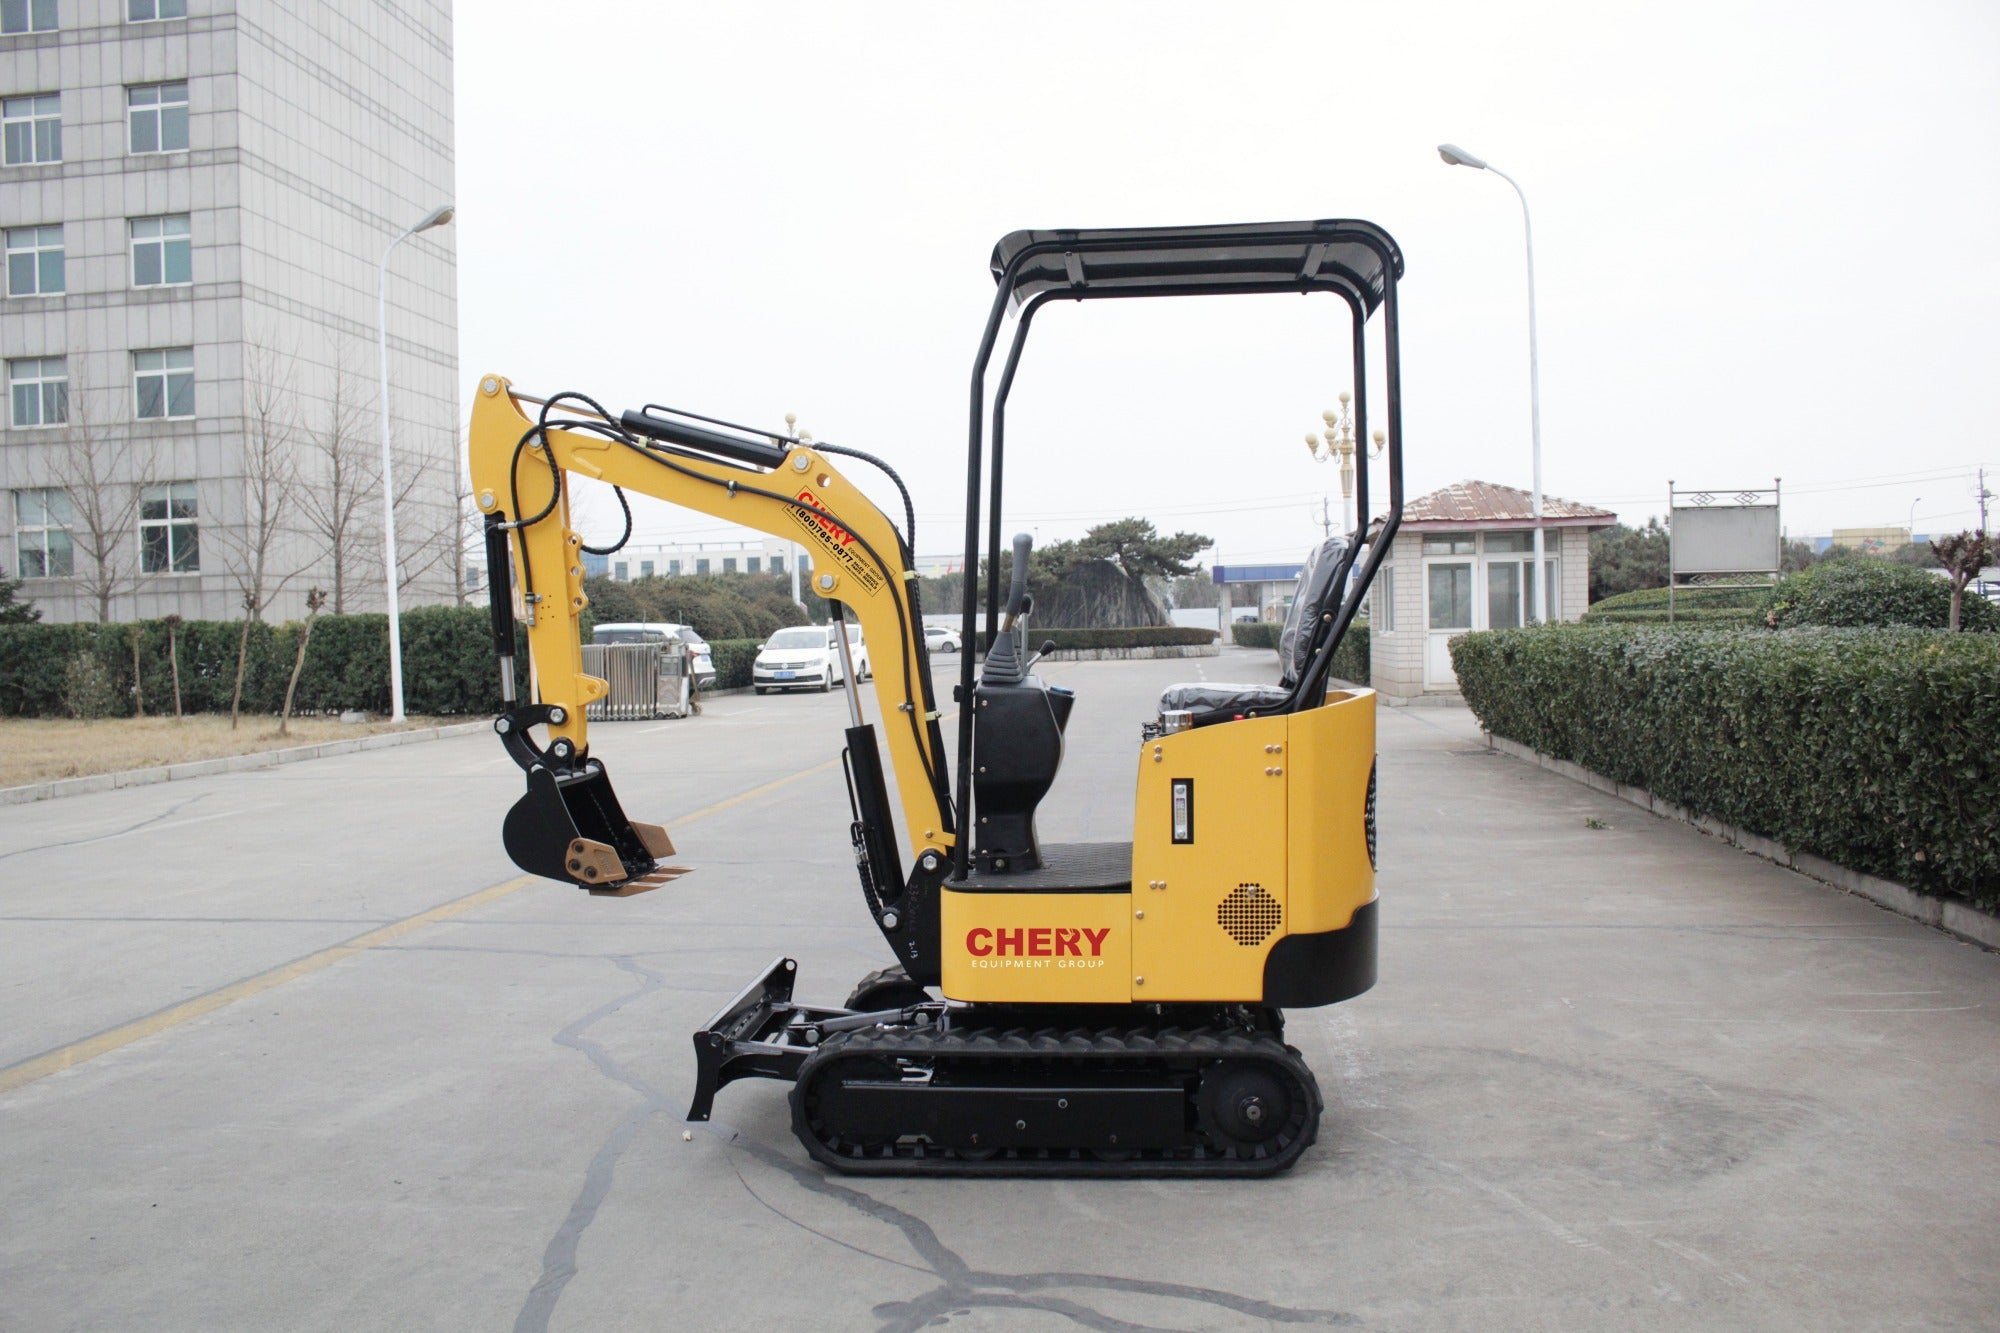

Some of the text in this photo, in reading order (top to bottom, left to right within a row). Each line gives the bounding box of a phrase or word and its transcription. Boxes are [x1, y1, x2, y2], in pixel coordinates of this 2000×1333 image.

[795, 507, 853, 563] (800)765-0877
[966, 927, 1111, 957] CHERY
[971, 959, 1105, 969] EQUIPMENT GROUP
